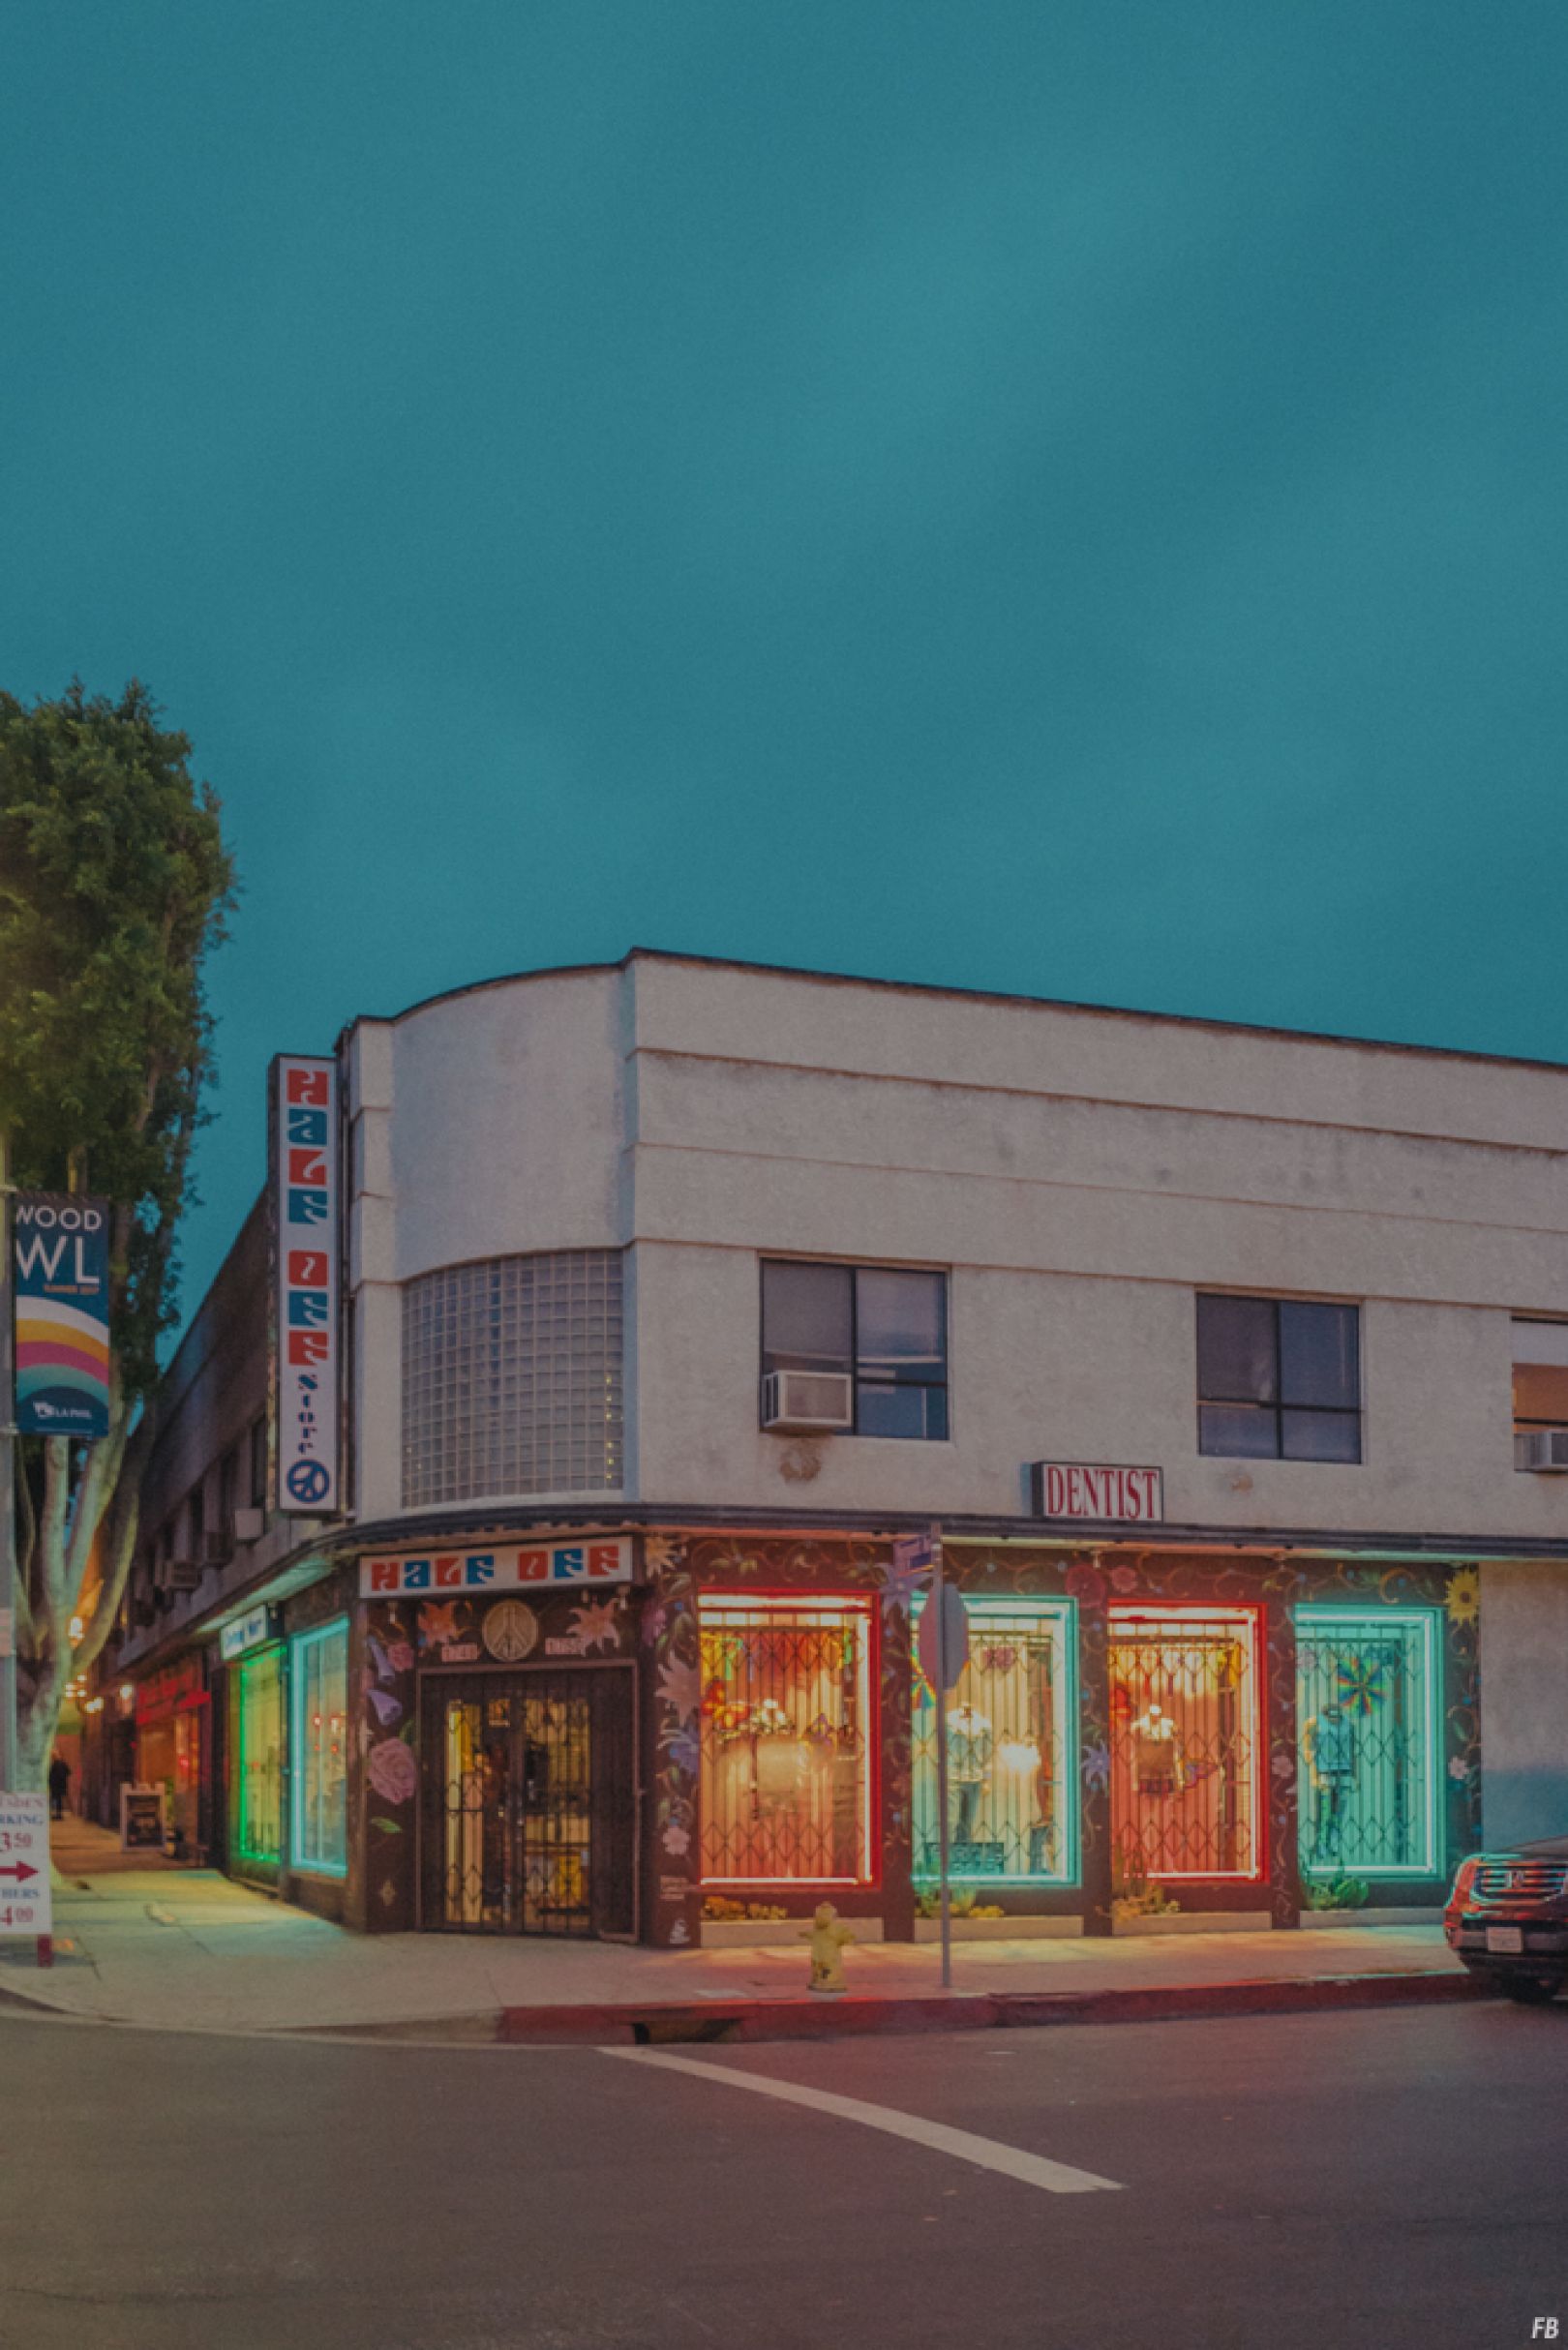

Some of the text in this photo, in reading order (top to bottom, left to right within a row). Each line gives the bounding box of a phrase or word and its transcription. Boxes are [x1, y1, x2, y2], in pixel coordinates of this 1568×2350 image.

[15, 1204, 102, 1231] WOOD
[15, 1233, 101, 1284] WL
[1046, 1465, 1159, 1521] DENTIST
